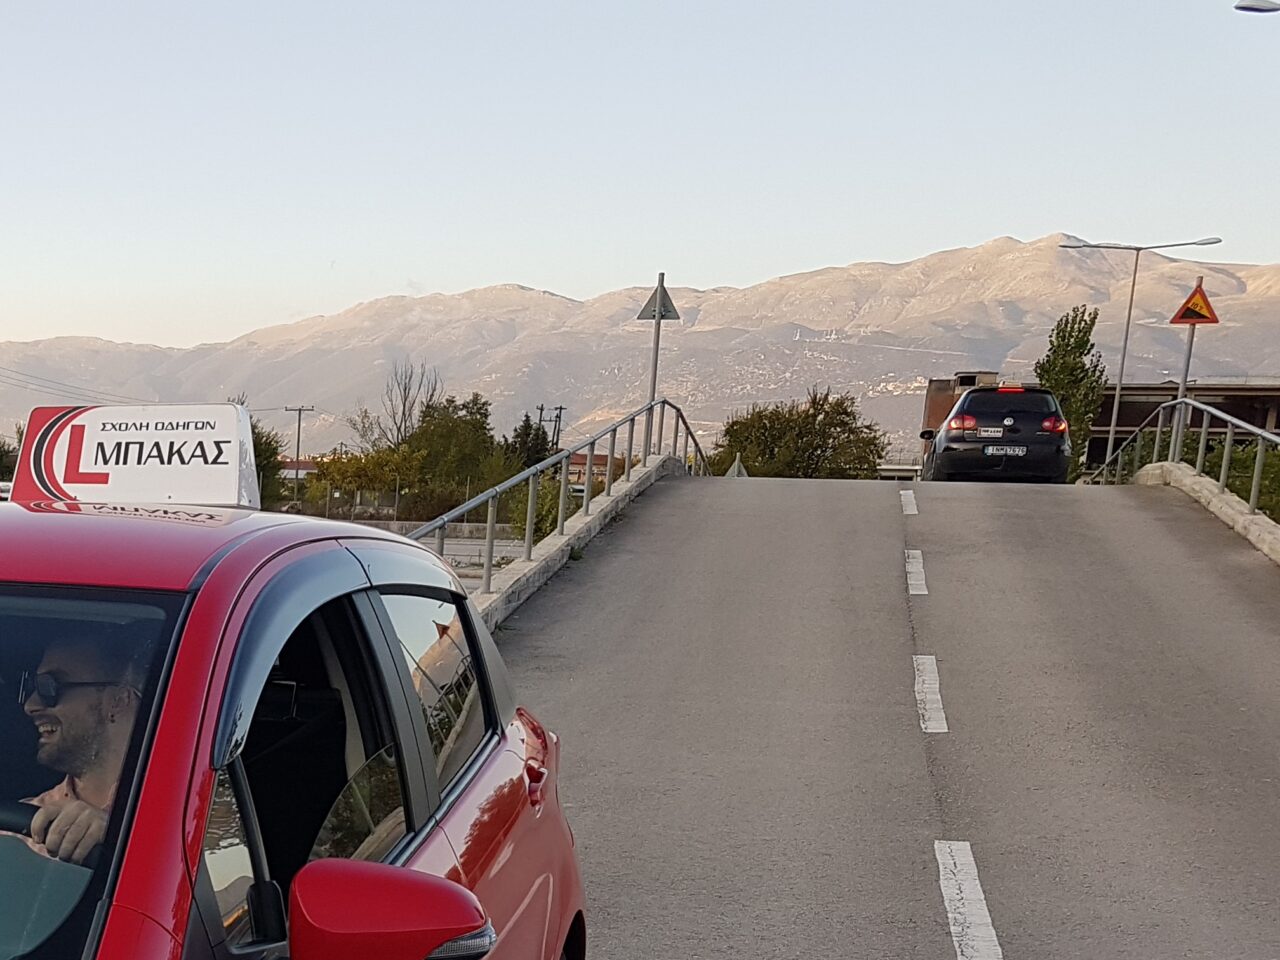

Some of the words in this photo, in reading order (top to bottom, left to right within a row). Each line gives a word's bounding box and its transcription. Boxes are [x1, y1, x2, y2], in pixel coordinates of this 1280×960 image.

[100, 421, 149, 432] ΣΧΟΛΗ
[154, 420, 216, 431] ΟΔΗΓΩΝ
[63, 424, 110, 485] L
[94, 440, 232, 466] ΜΠΑΚΑΣ
